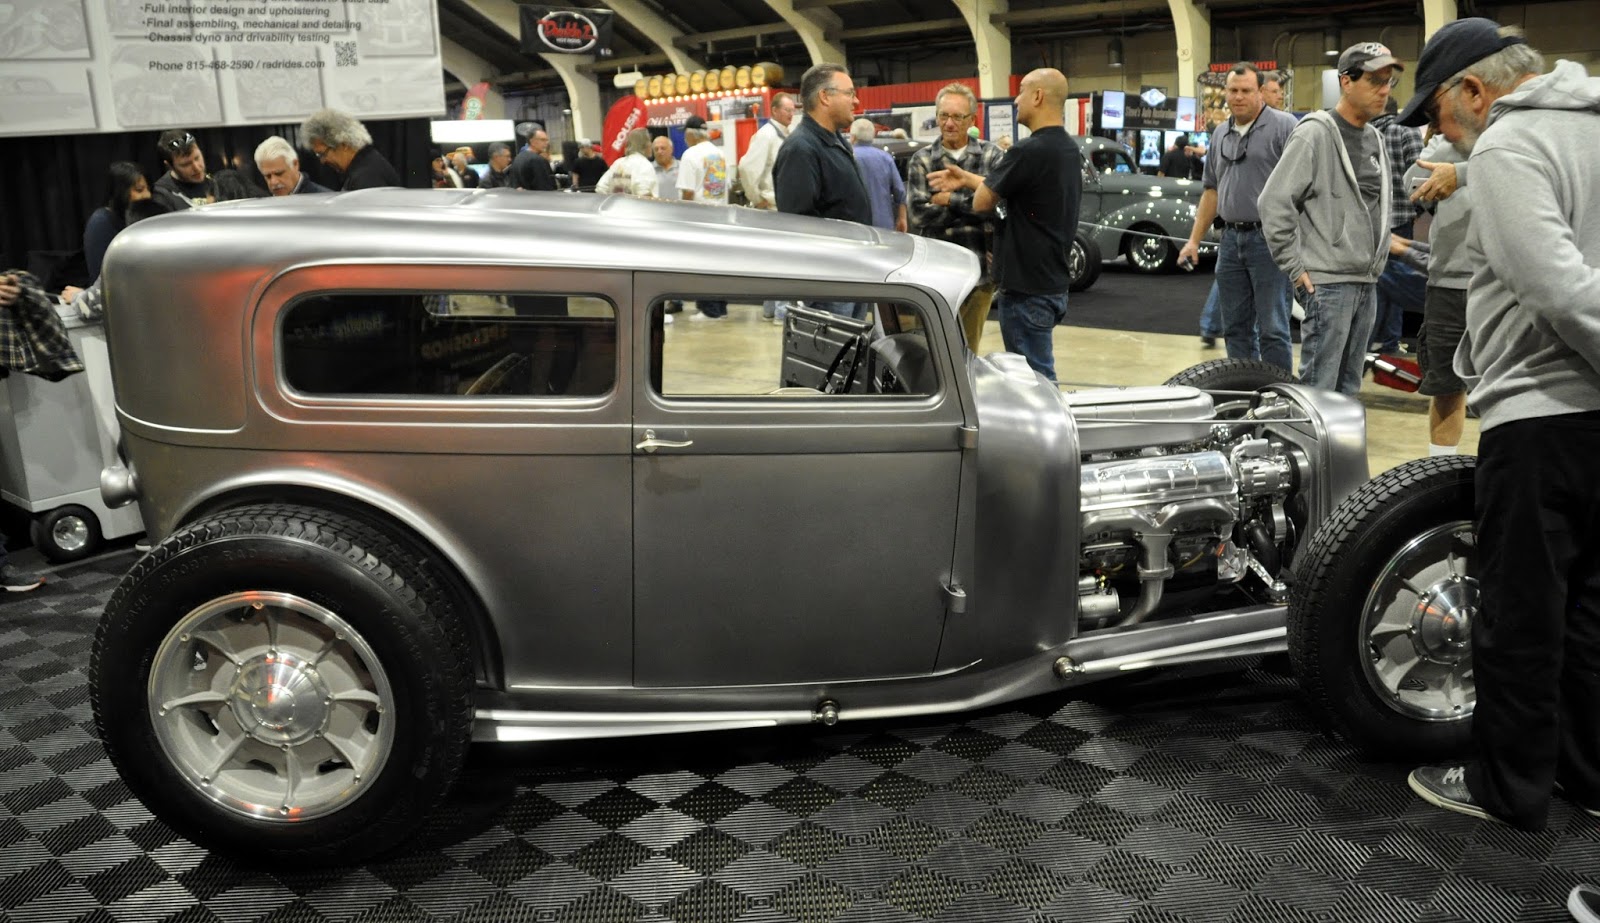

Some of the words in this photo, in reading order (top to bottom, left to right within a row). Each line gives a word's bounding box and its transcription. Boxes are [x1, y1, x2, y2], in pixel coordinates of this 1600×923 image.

[145, 4, 165, 14] Full
[168, 4, 206, 14] interior
[210, 5, 245, 17] design
[248, 6, 266, 15] and
[270, 6, 330, 17] upholstering
[147, 18, 173, 28] Final
[176, 19, 240, 30] assembling,
[243, 19, 299, 29] mechanical
[301, 20, 319, 29] and
[322, 19, 361, 31] detailing
[149, 32, 192, 42] Chassis
[195, 33, 221, 44] dyno
[224, 33, 243, 42] and
[246, 33, 295, 44] drivability
[298, 33, 330, 44] testing
[149, 61, 183, 71] Phone
[186, 60, 254, 71] 815-468-2590
[262, 59, 325, 70] radrides.com
[611, 107, 642, 151] ROUSH
